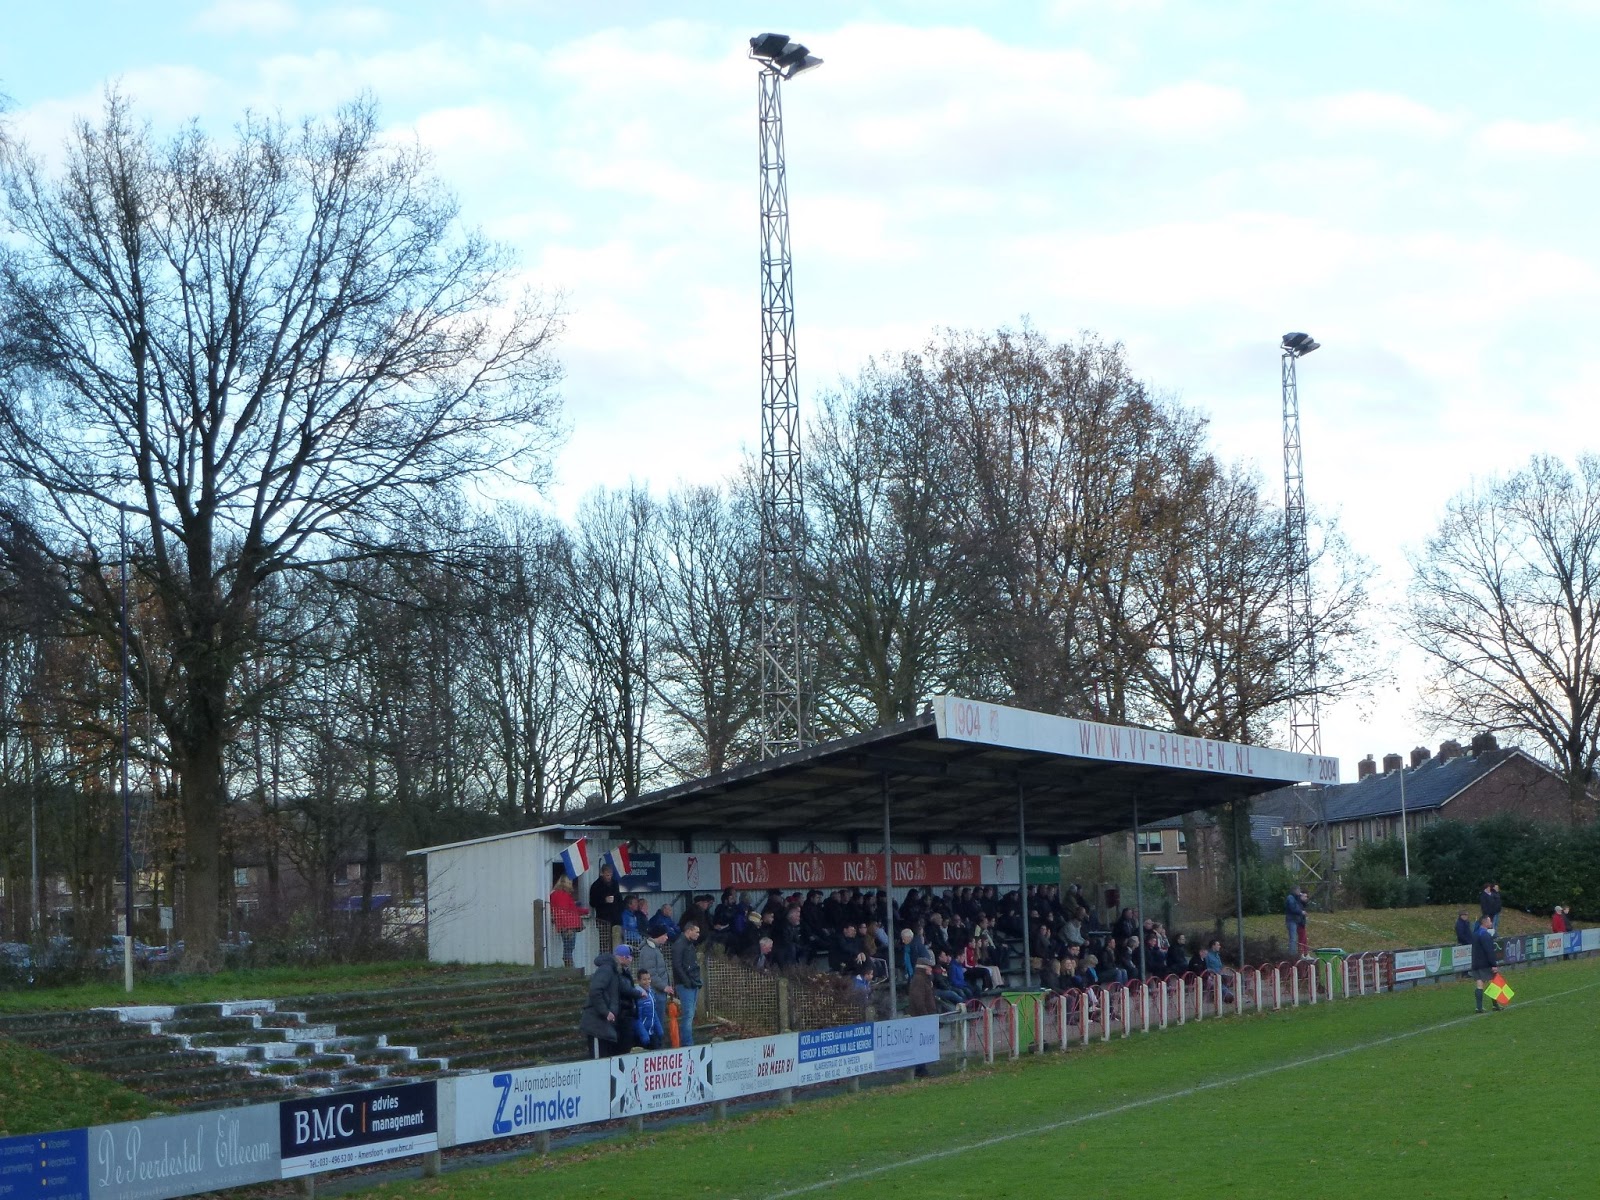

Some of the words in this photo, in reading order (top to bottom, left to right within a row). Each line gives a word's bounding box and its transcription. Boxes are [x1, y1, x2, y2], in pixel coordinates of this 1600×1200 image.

[953, 702, 981, 737] 1904
[1078, 722, 1254, 775] WWW.VV-RHEDEN.NL
[1319, 758, 1337, 782] 2004
[731, 862, 754, 884] ING
[788, 861, 811, 883] ING
[843, 861, 864, 881] ING
[894, 861, 914, 881] ING
[943, 861, 962, 881] ING
[763, 1043, 776, 1059] VAN
[644, 1052, 684, 1074] ENERGIE
[757, 1063, 769, 1078] DER
[769, 1060, 786, 1076] MEER
[786, 1057, 795, 1073] BV
[513, 1067, 582, 1093] Automobielbedrijf
[644, 1070, 683, 1092] SERVICE
[372, 1094, 399, 1112] advies
[492, 1073, 582, 1135] Zeilmaker
[294, 1103, 354, 1145] BMC
[372, 1109, 424, 1132] management
[216, 1114, 271, 1168] Ellecom
[357, 1148, 384, 1160] Amersfoort
[387, 1142, 414, 1155] www.bmc.nl
